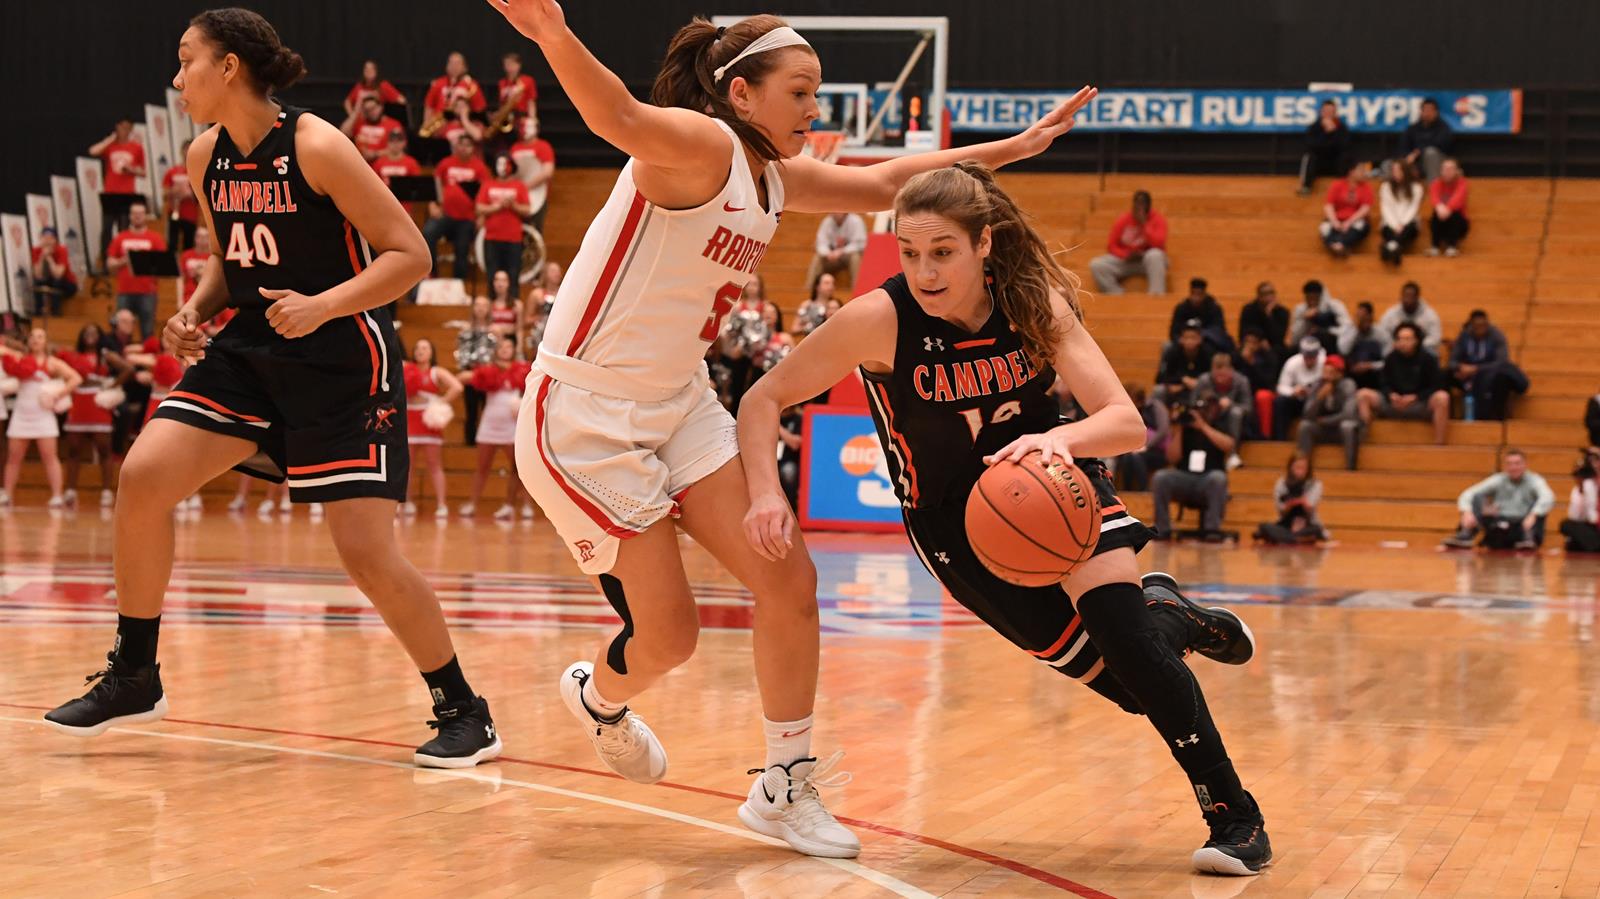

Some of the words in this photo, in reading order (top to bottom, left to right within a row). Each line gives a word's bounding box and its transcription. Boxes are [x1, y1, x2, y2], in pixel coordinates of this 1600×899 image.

[1202, 97, 1317, 126] RULES
[210, 179, 298, 213] CAMPBELL
[225, 222, 280, 268] 40
[701, 225, 769, 274] RADFO
